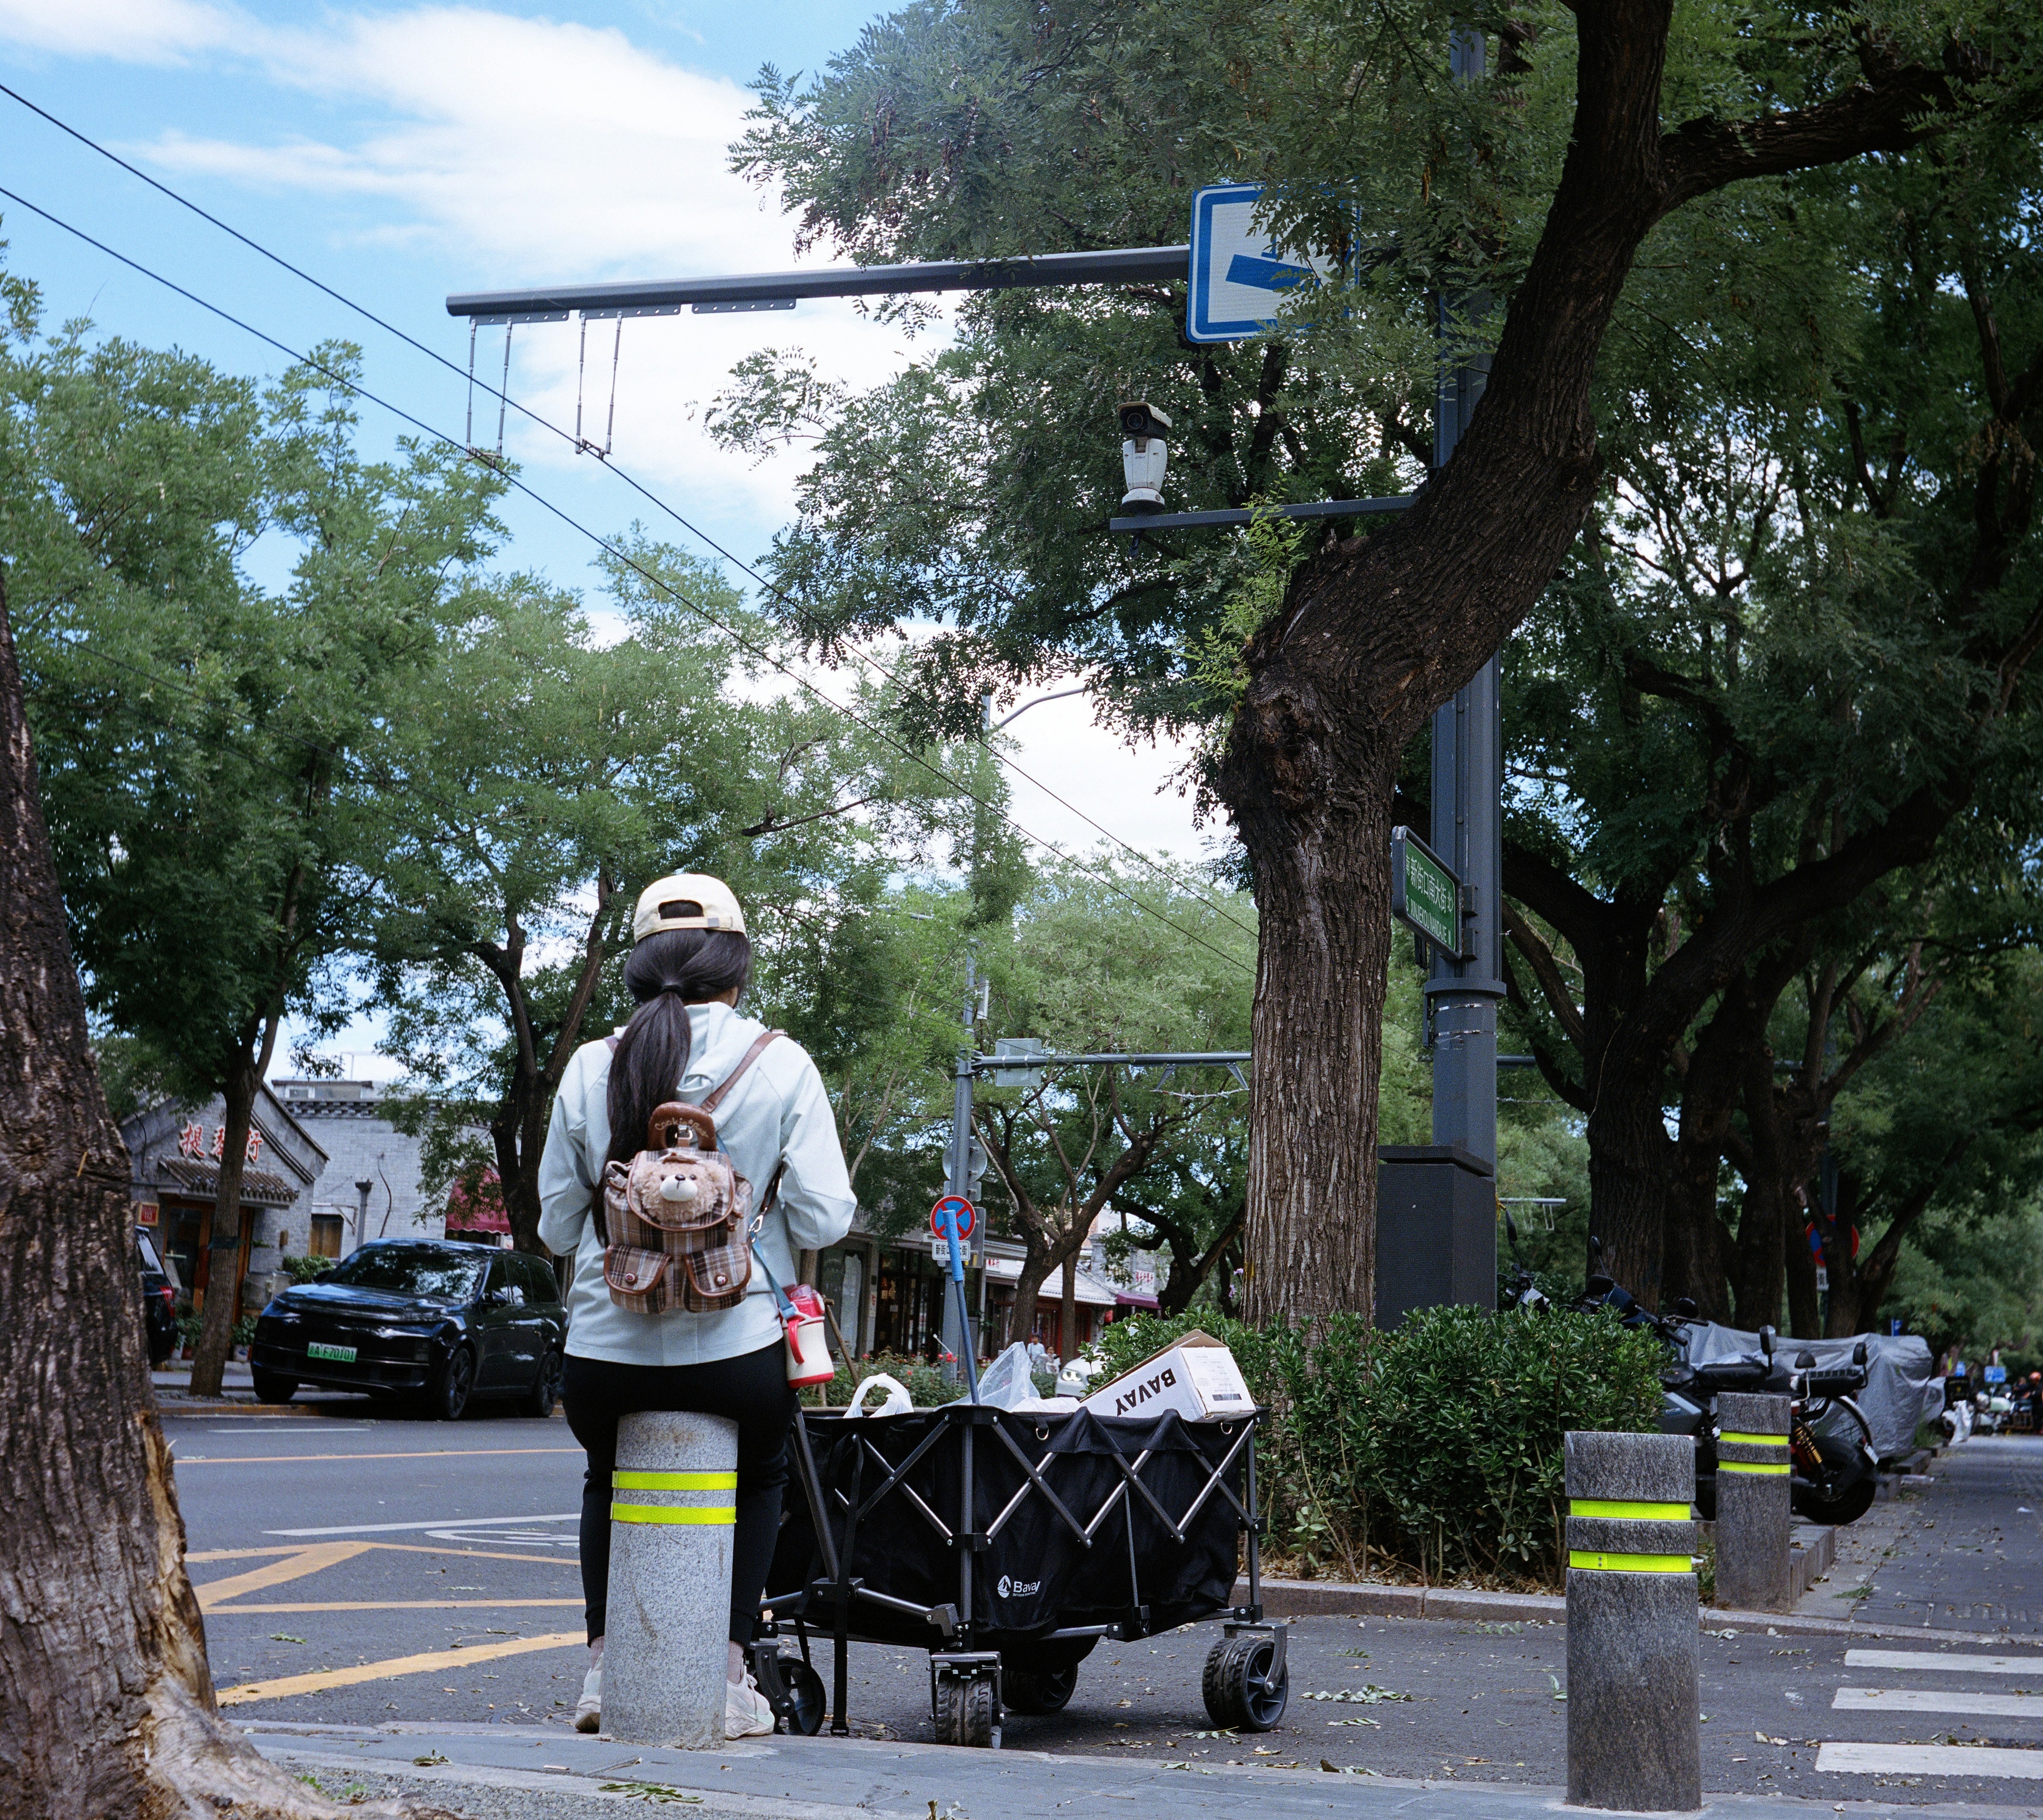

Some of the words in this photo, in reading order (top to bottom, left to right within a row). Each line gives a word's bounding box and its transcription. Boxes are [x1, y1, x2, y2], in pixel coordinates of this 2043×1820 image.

[1411, 856, 1446, 913] 新街口南大街
[1115, 1368, 1177, 1417] BAVAY
